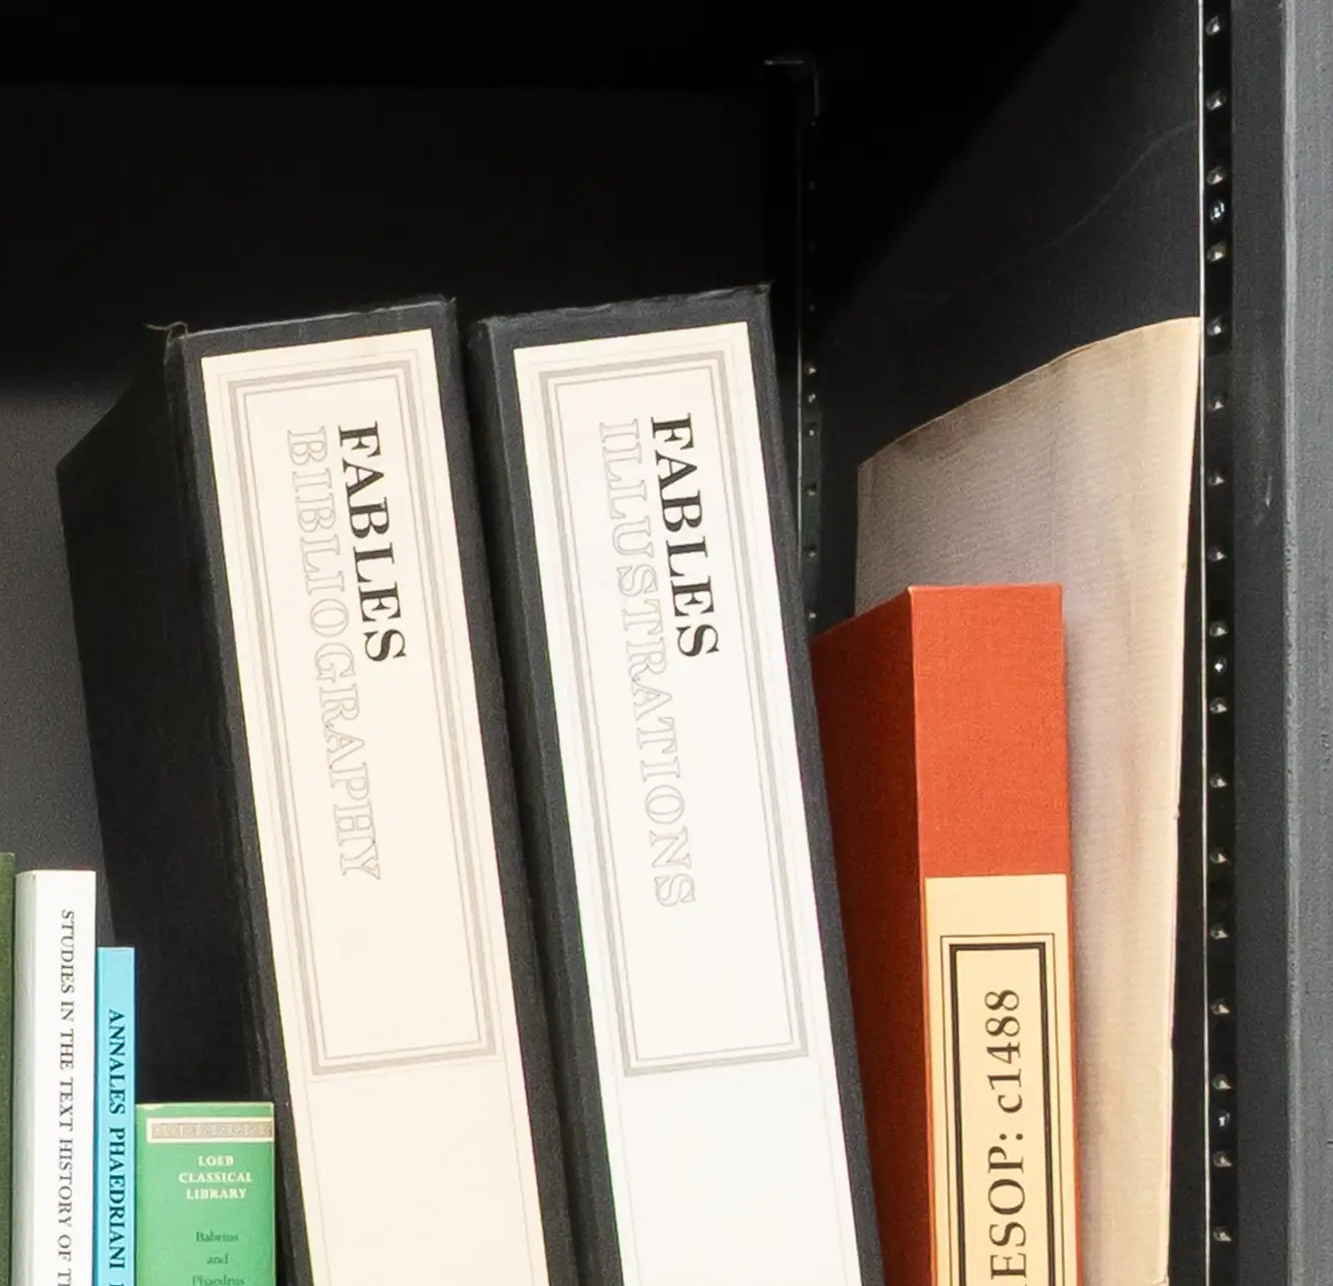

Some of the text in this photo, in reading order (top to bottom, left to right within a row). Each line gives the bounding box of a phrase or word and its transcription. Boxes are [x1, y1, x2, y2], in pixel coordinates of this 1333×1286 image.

[338, 419, 407, 663] FABLES
[650, 412, 719, 658] FABLES
[286, 425, 381, 880] BIBLIOGRAPHY
[598, 417, 695, 907] ILLUSTRATIONS
[61, 910, 74, 993] STUDIES
[60, 1029, 73, 1069] THE
[61, 1002, 73, 1020] IN
[985, 990, 1022, 1113] c1488
[60, 1078, 73, 1131] TEXT
[109, 1010, 125, 1114] ANNALES
[58, 1138, 74, 1227] HISTORY
[109, 1128, 125, 1268] PHAEDRIANI
[179, 1171, 253, 1183] CLASSICAL
[187, 1188, 246, 1199] LIBRARY
[199, 1156, 233, 1166] LOEB
[58, 1234, 71, 1261] OF
